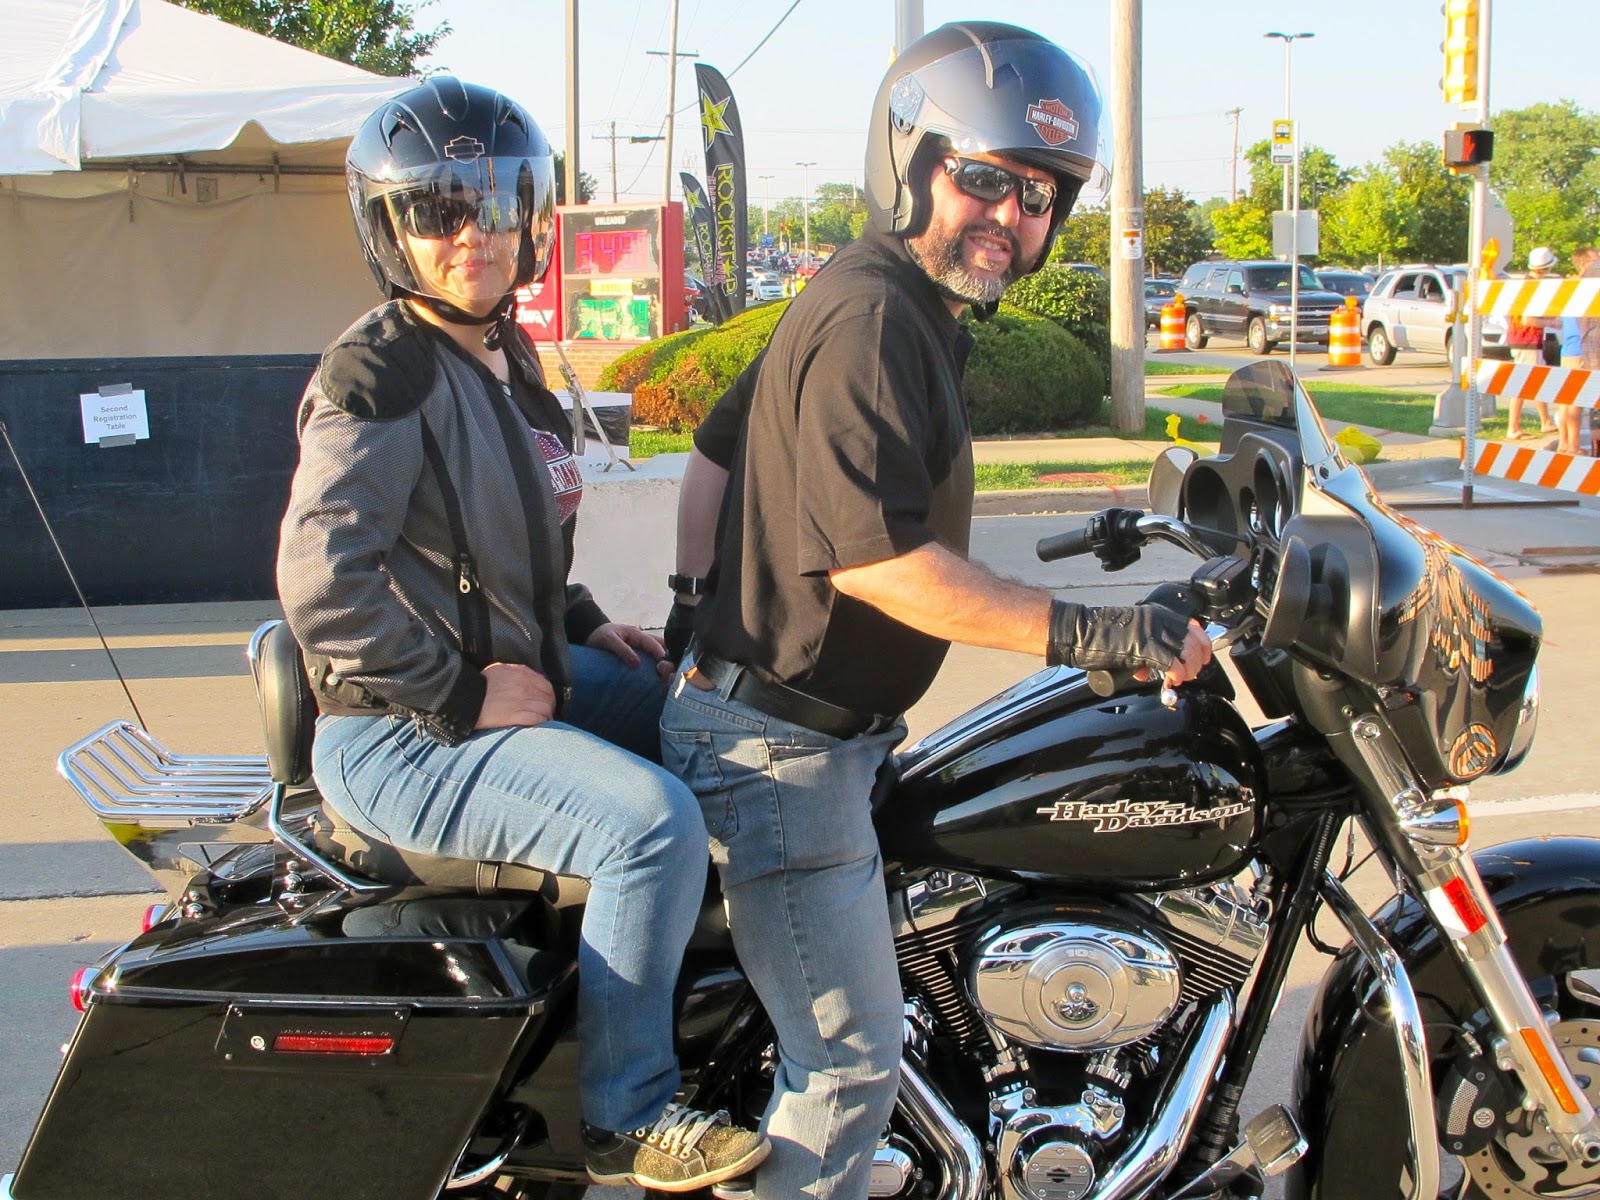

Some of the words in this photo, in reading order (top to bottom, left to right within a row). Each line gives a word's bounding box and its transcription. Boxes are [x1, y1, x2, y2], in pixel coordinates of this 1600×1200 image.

[1031, 110, 1075, 134] HARLEY-DAVIDSON
[594, 215, 627, 226] UNLEADED
[101, 404, 128, 413] Second
[93, 413, 137, 423] Registration
[1036, 799, 1184, 823] Harley
[1083, 803, 1250, 833] Davidson
